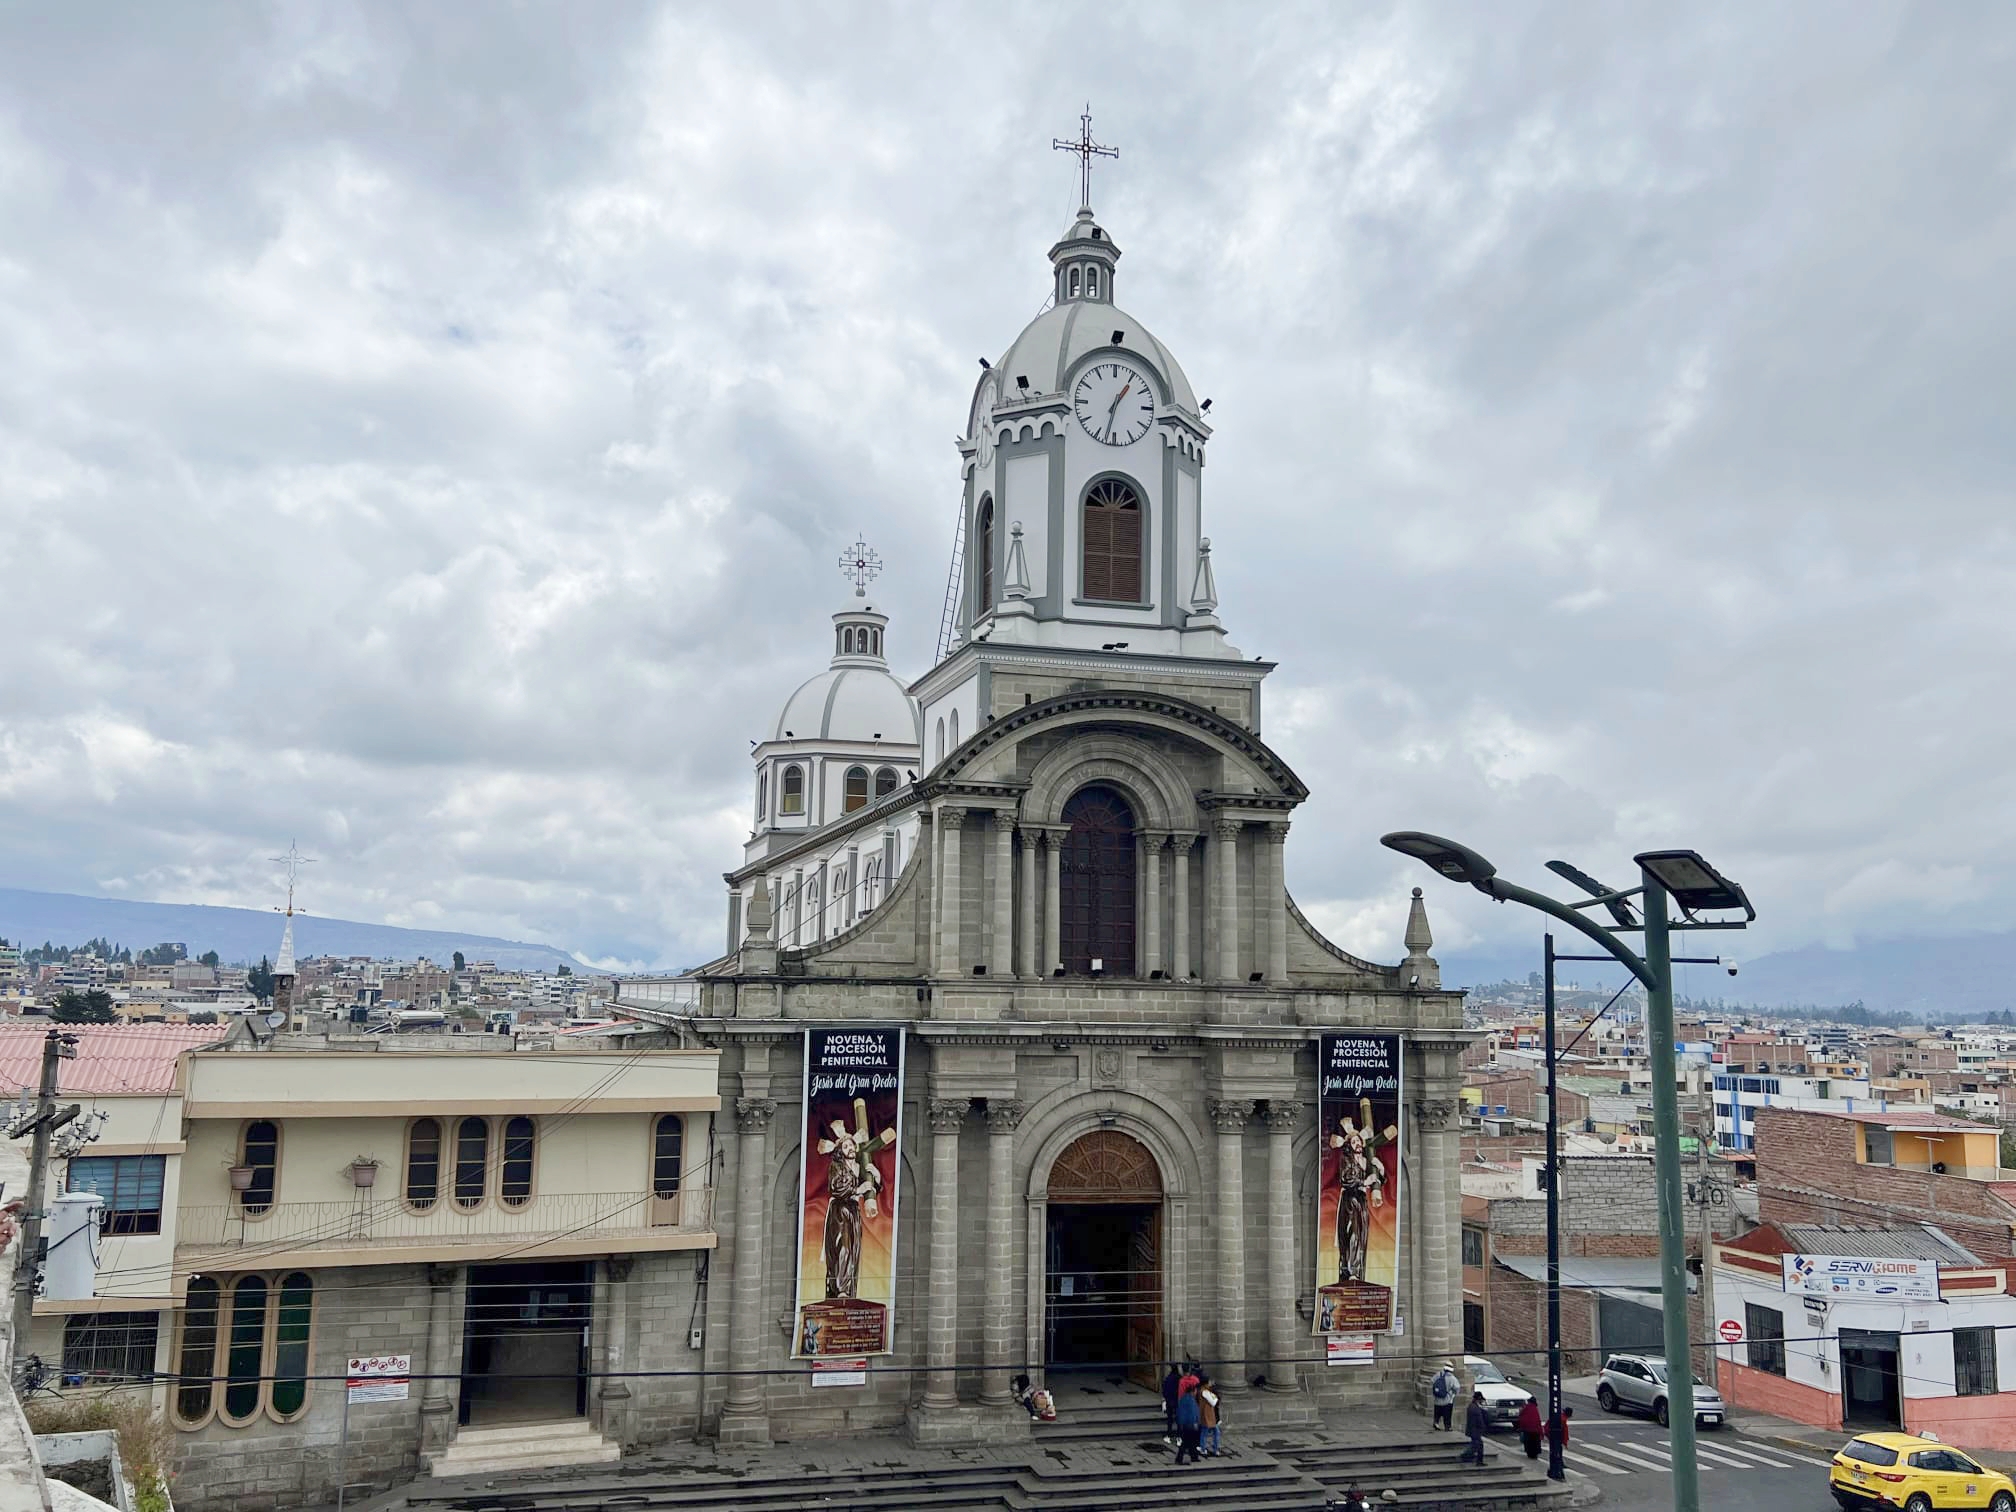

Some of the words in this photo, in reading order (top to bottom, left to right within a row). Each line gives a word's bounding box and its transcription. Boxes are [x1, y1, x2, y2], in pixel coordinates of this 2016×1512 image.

[827, 1035, 873, 1045] NOVENA
[877, 1035, 884, 1044] Y
[1335, 1039, 1376, 1048] NOVENA
[1379, 1040, 1385, 1048] Y
[824, 1041, 886, 1054] PROCESIÓN
[1333, 1046, 1388, 1057] PROCESIÓN
[821, 1056, 888, 1066] PENITENCIAL
[1331, 1059, 1389, 1068] PENITENCIAL
[834, 1073, 848, 1089] del
[848, 1073, 870, 1096] Gran
[872, 1073, 897, 1092] Poder
[1343, 1074, 1355, 1089] del
[1355, 1075, 1374, 1096] Gran
[1376, 1075, 1397, 1092] Poder
